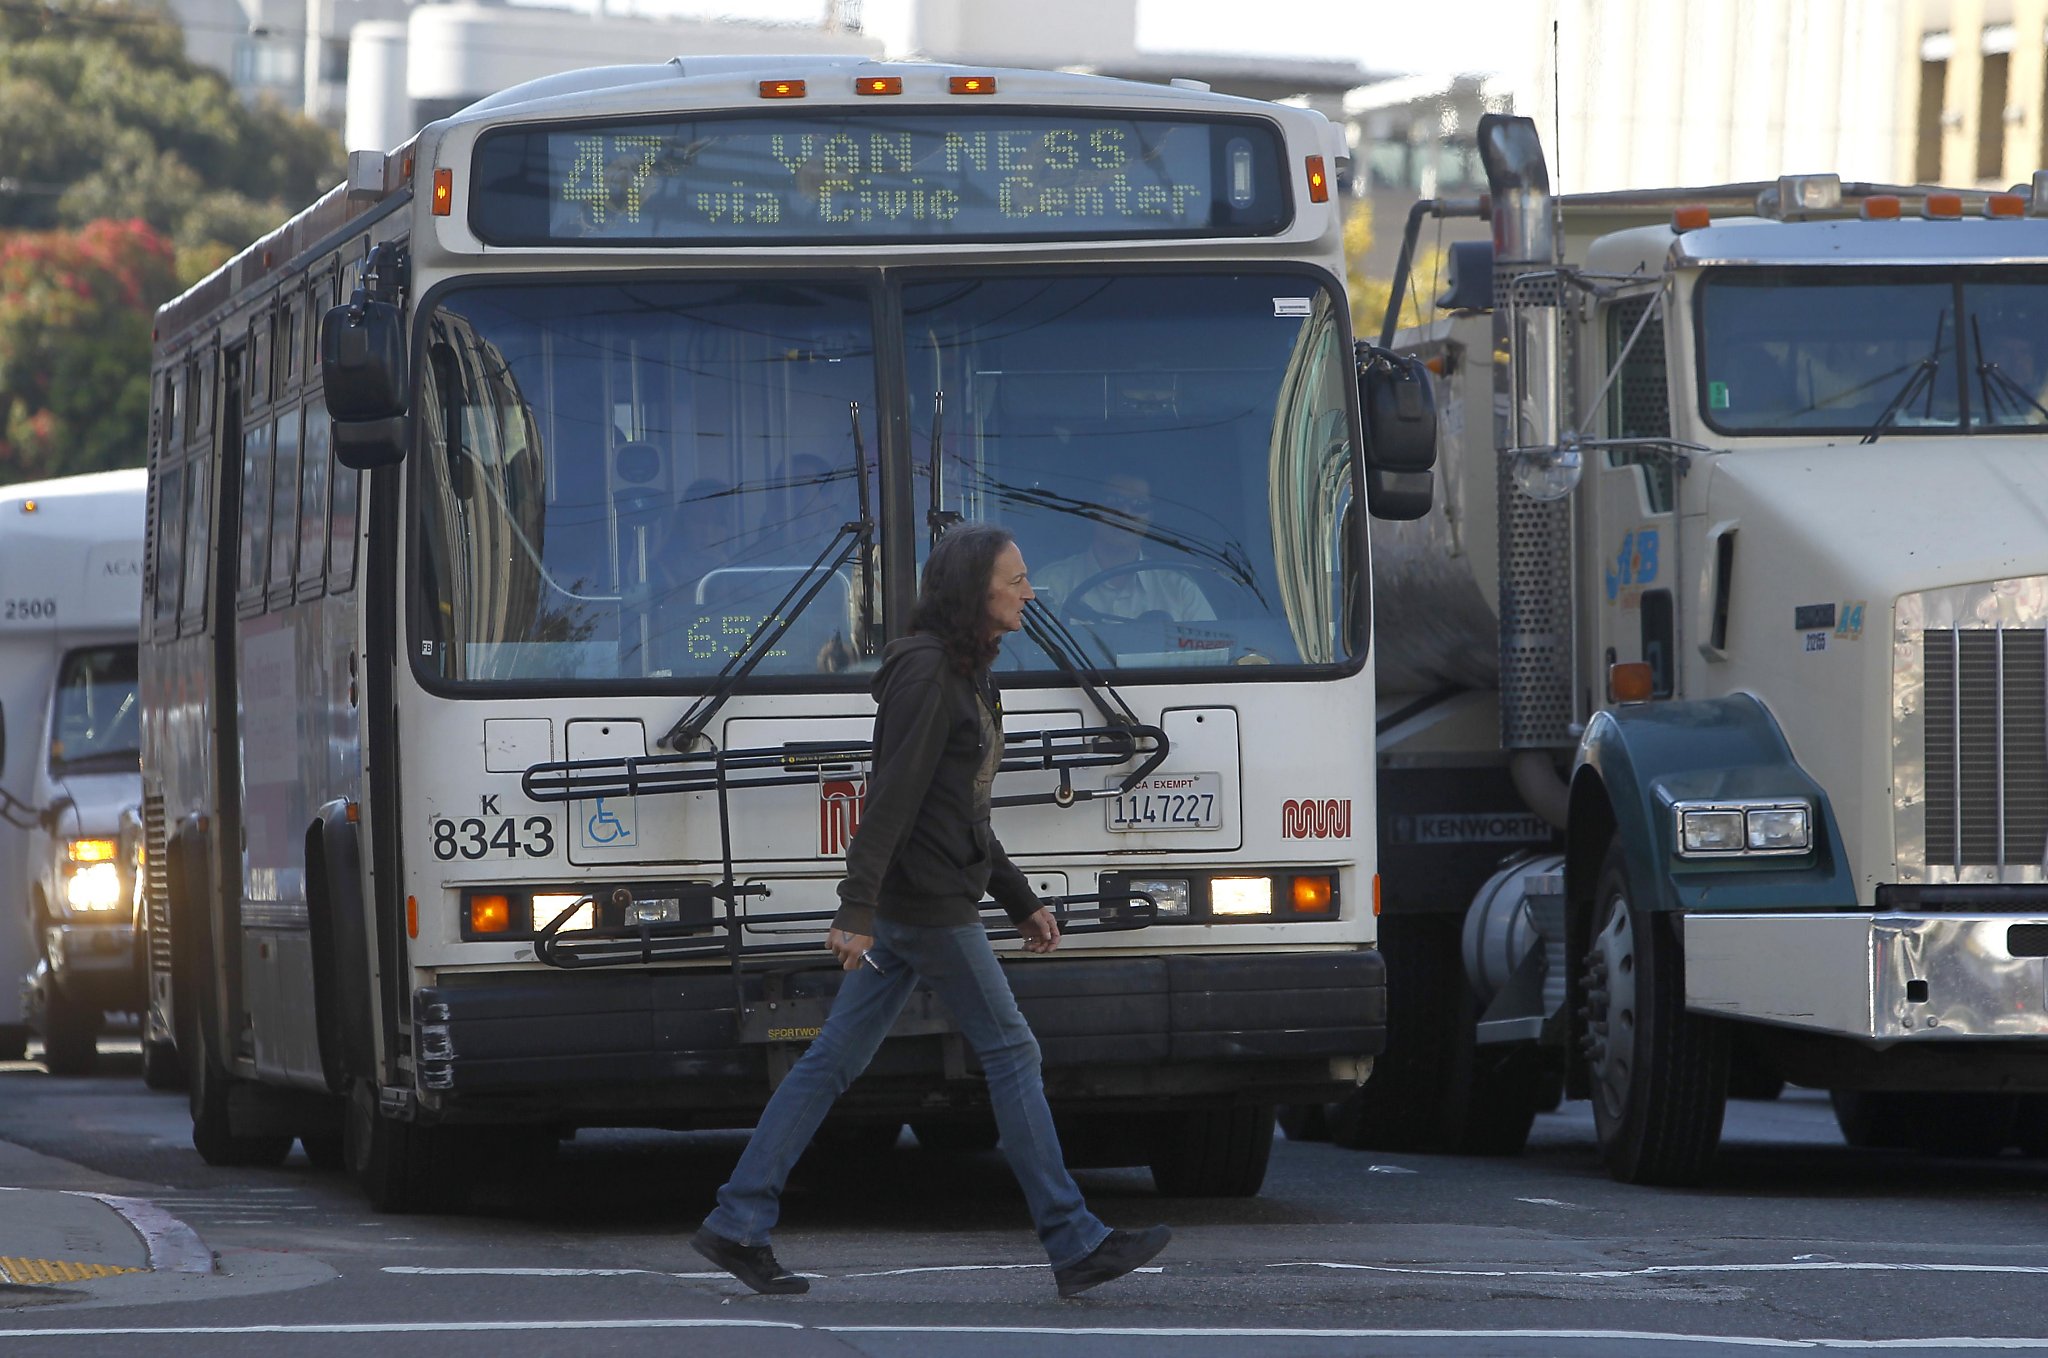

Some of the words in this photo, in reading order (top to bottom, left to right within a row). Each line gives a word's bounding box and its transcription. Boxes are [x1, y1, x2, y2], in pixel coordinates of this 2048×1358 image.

[563, 135, 661, 223] 47
[772, 131, 912, 174] VAN
[945, 128, 1126, 172] NESS
[698, 179, 779, 223] via
[819, 178, 959, 222] Civic
[999, 174, 1201, 218] Center
[104, 561, 142, 576] ACA
[5, 599, 56, 620] 2500
[1134, 780, 1149, 789] CA
[1153, 779, 1194, 789] EXEMPT
[482, 794, 500, 815] K
[1114, 794, 1214, 823] 1147227
[433, 816, 555, 860] 8343
[1421, 817, 1549, 838] KENWORTH
